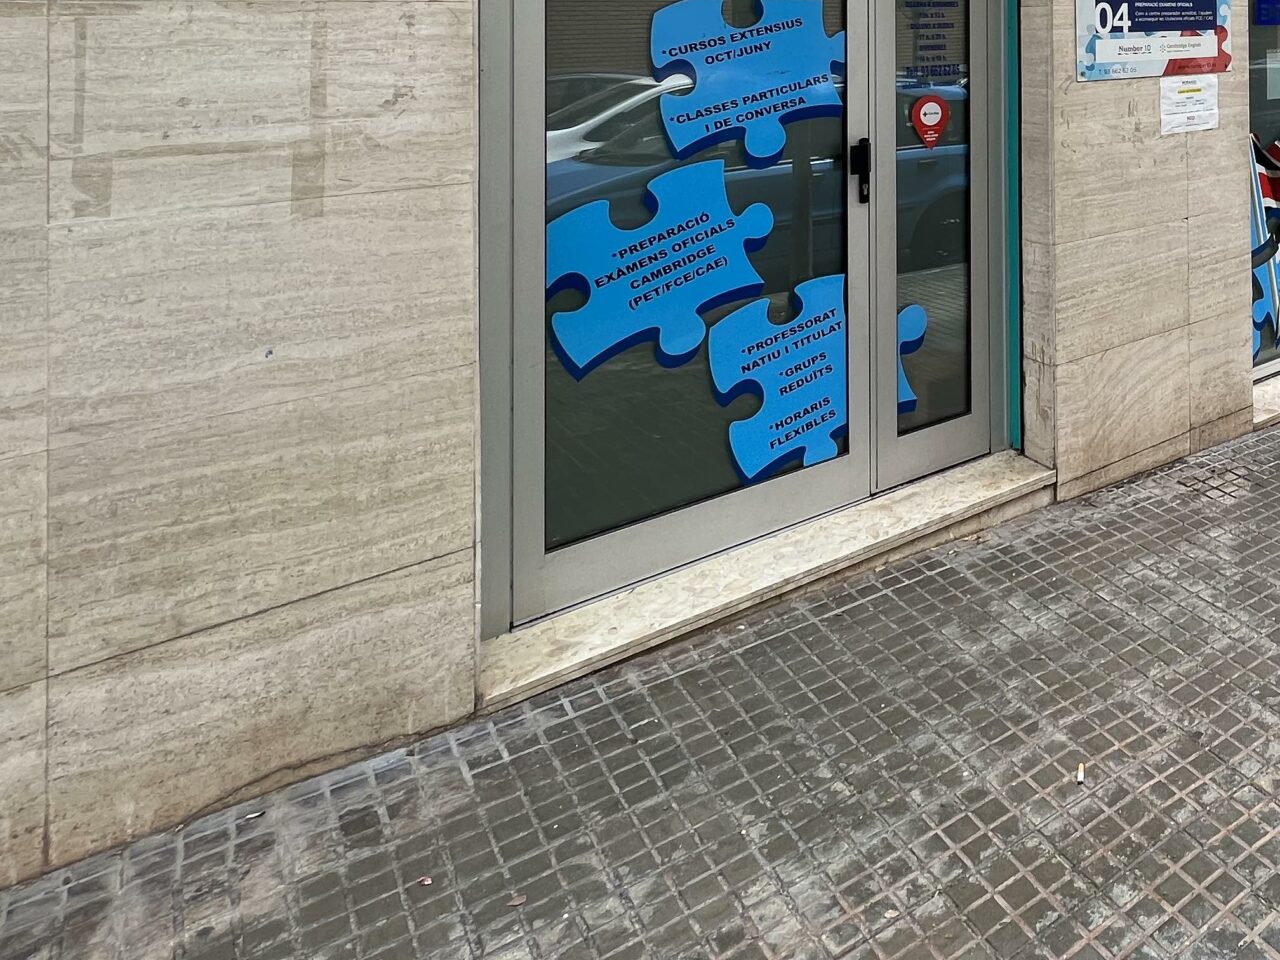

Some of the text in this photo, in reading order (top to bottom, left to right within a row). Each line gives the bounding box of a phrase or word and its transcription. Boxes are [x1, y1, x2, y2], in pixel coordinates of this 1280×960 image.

[669, 17, 803, 57] CURSOS EXTENSIUS
[1094, 2, 1132, 33] 04
[705, 41, 772, 65] OCT/JUNY
[1119, 44, 1143, 53] Number
[676, 74, 829, 124] CLASSES PARTICULARS
[705, 96, 807, 133] I DE CONVERSA
[594, 218, 736, 289] EXÀMENS OFICIALS
[618, 211, 710, 260] PREPARACIÓ
[628, 256, 729, 311] (PET/FCE/CAE)
[629, 244, 716, 290] CAMBRIDGE
[741, 321, 843, 374] NATIU I TITULAT
[746, 308, 837, 356] PROFESSORAT
[785, 352, 827, 377] GRUPS
[769, 409, 837, 450] FLEXIBLES
[774, 397, 831, 431] HORARIS
